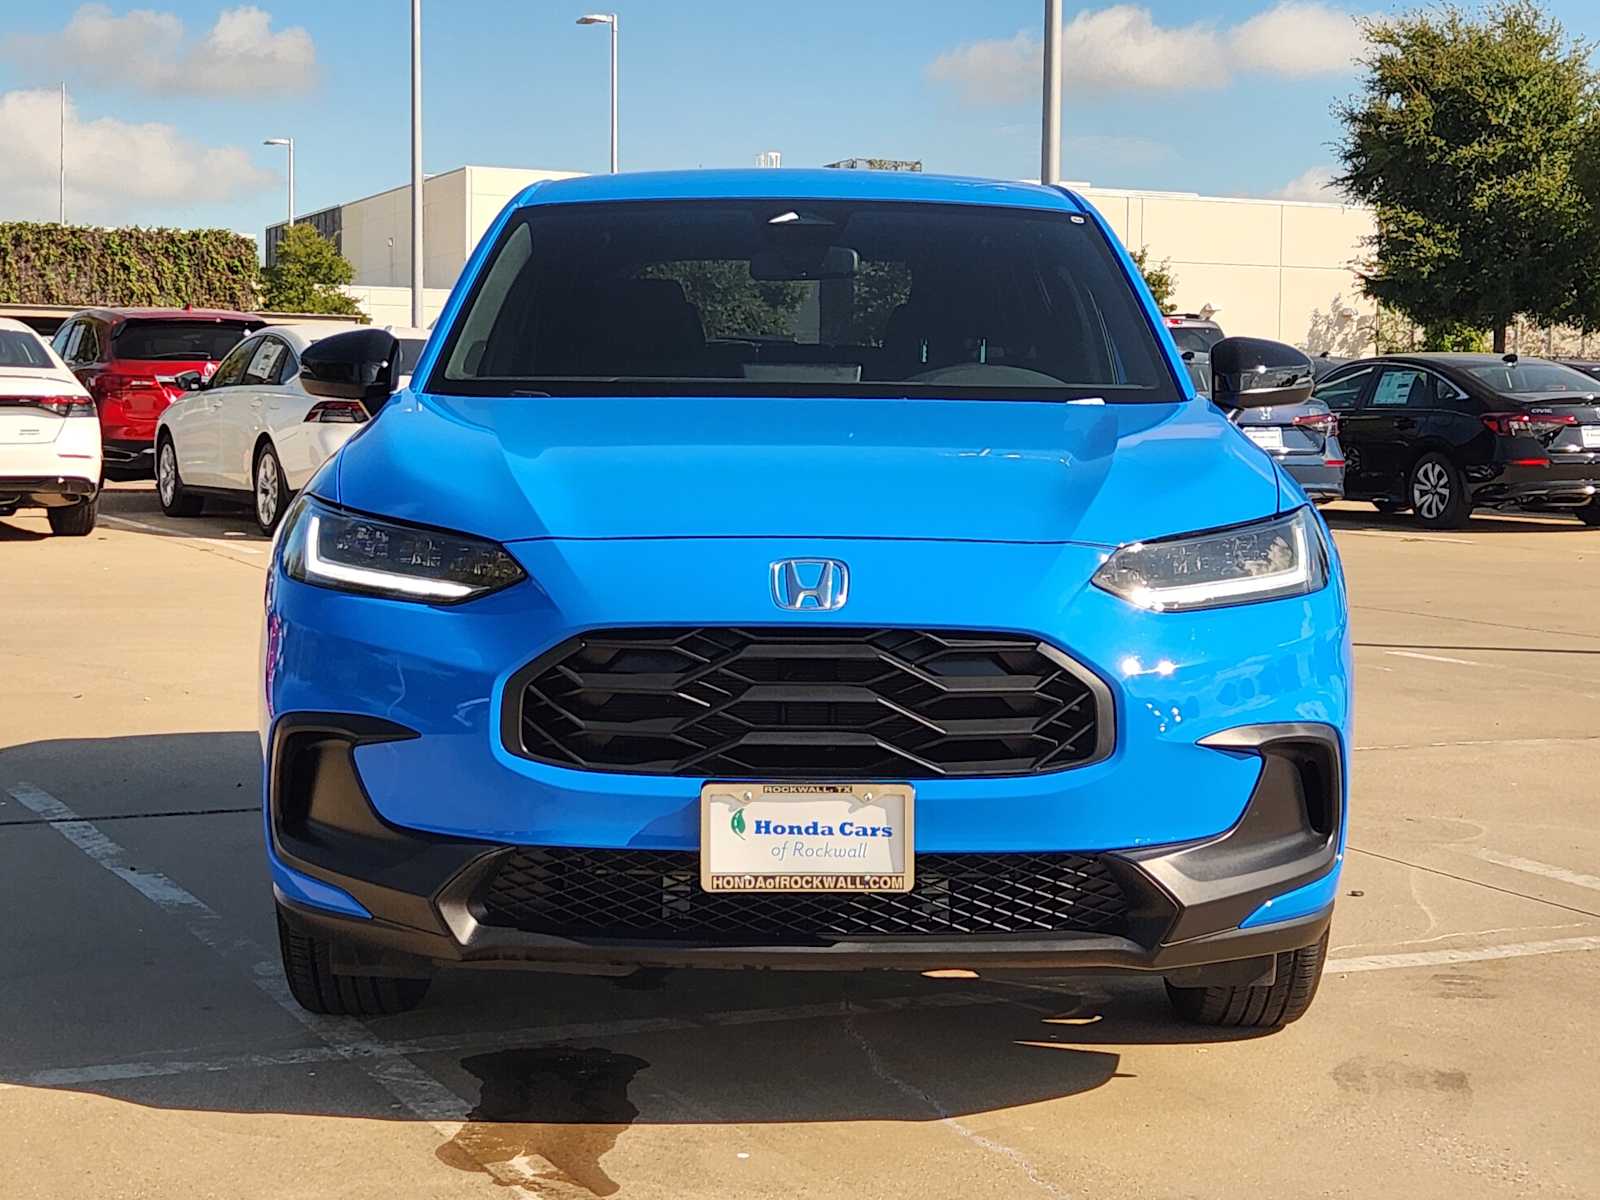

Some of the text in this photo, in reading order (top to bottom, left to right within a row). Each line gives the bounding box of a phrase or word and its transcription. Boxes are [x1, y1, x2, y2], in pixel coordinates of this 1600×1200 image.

[754, 819, 893, 837] Honda Cars
[771, 841, 868, 861] of Rockwall
[712, 875, 904, 890] HONDAofROCKWALL.COM
